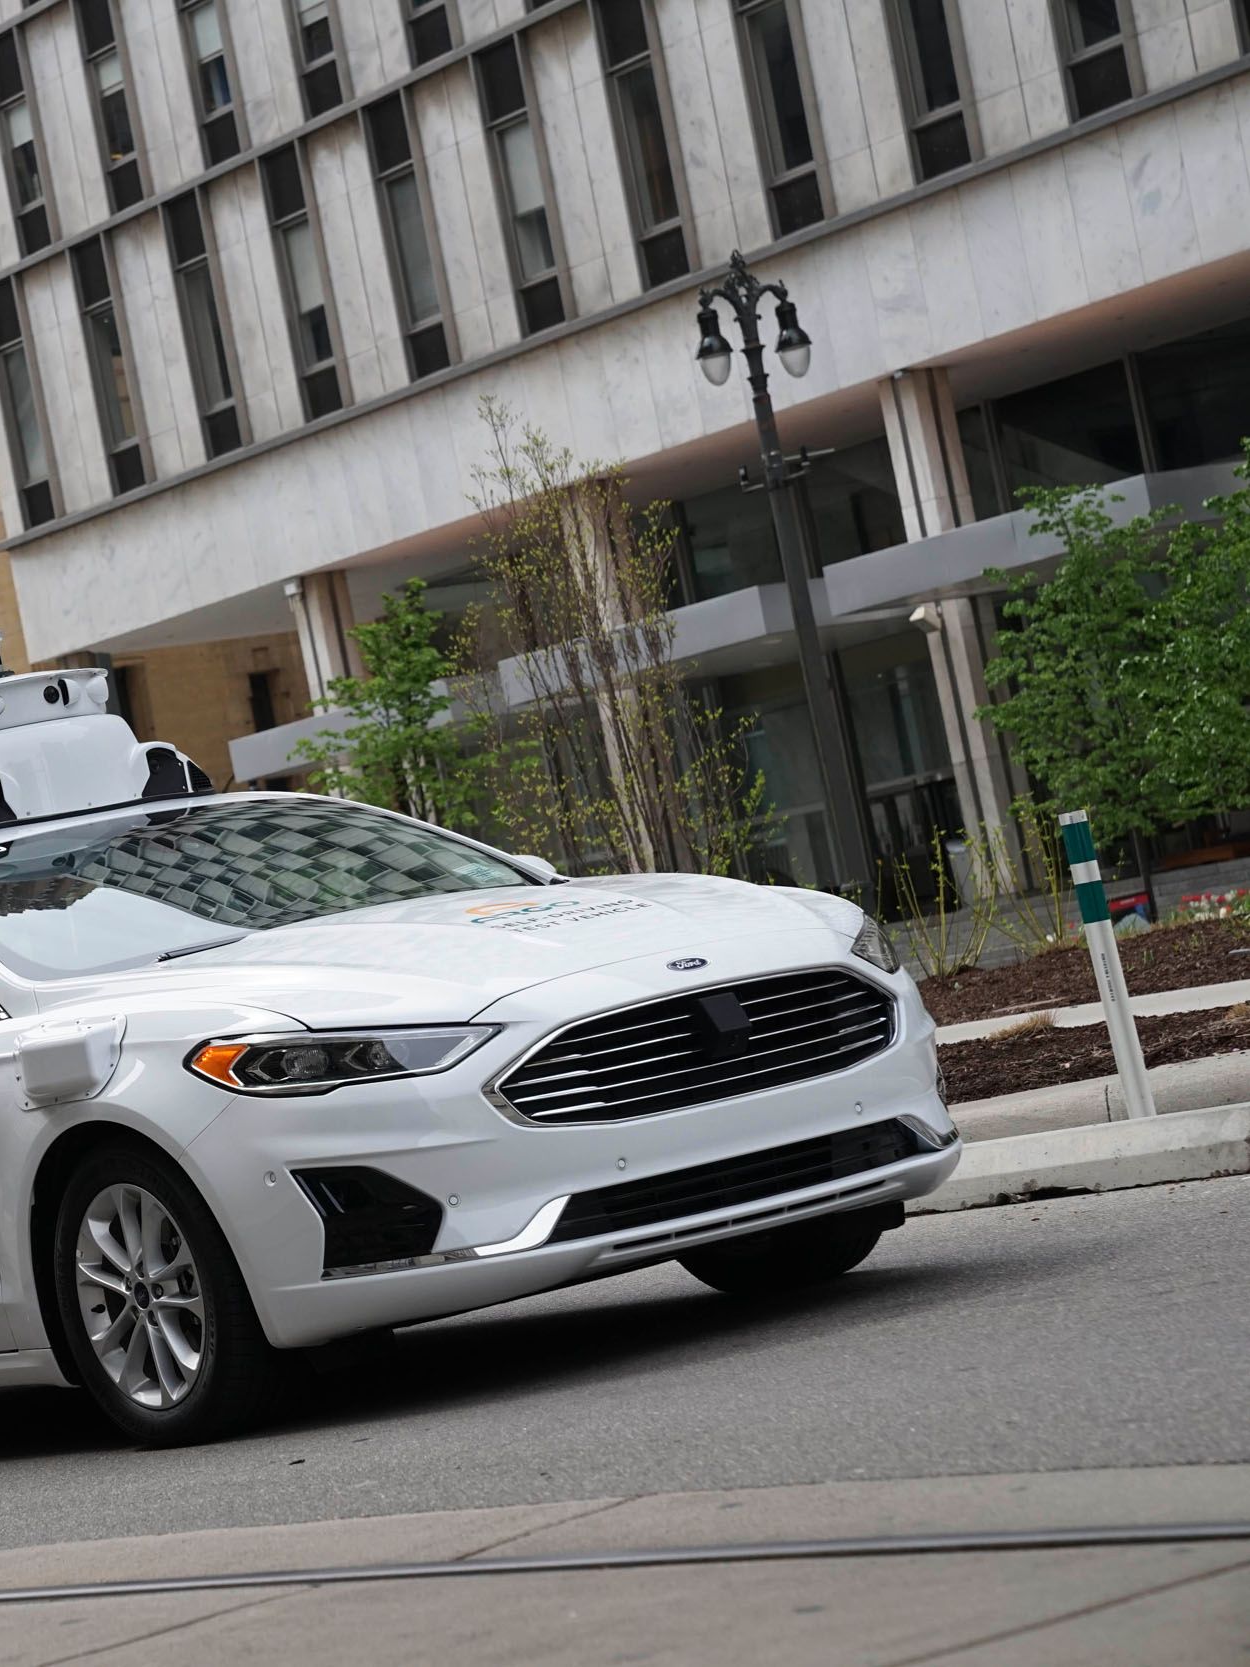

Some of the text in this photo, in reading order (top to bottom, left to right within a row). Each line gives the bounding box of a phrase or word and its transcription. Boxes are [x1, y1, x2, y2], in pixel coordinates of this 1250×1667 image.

[470, 900, 580, 924] ARGO
[490, 899, 633, 929] SELF-DRIVING
[509, 902, 652, 933] TEST VEHICLE
[675, 959, 702, 969] Ford
